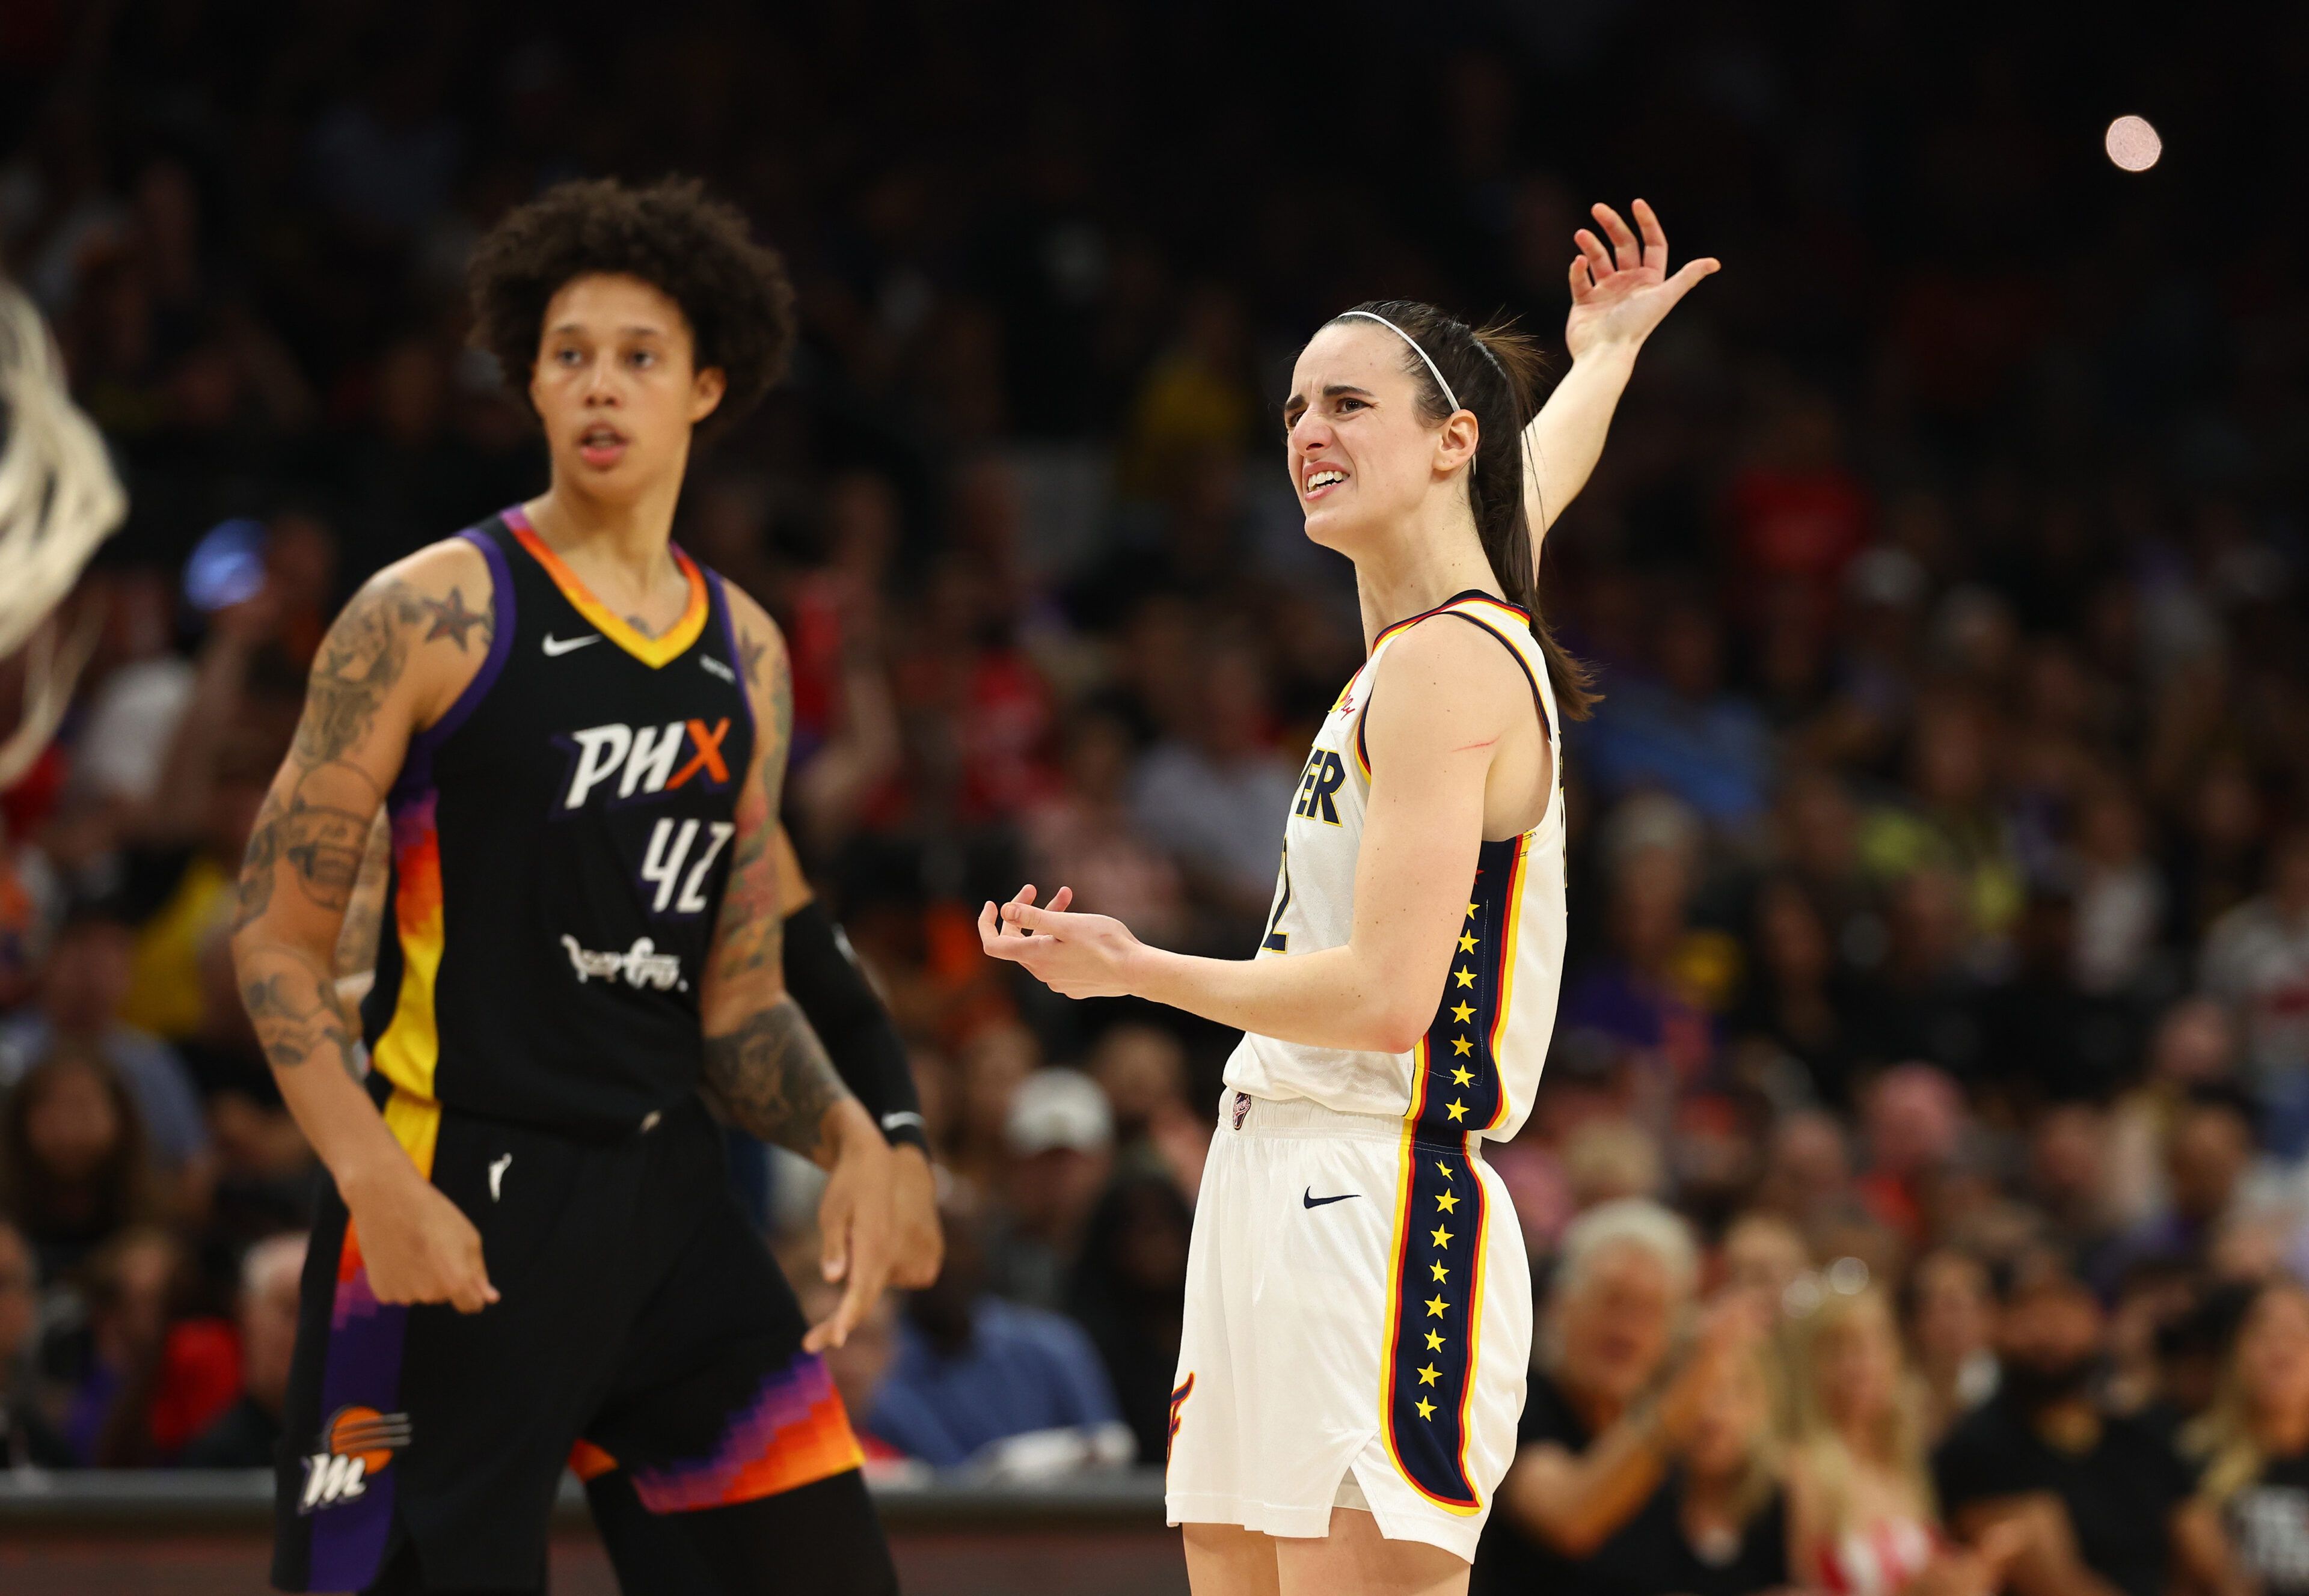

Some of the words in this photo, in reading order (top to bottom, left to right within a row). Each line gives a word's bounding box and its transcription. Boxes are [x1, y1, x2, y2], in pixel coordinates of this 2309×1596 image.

[564, 717, 731, 810] PHX
[1294, 745, 1346, 827] ER
[641, 818, 735, 914] 42
